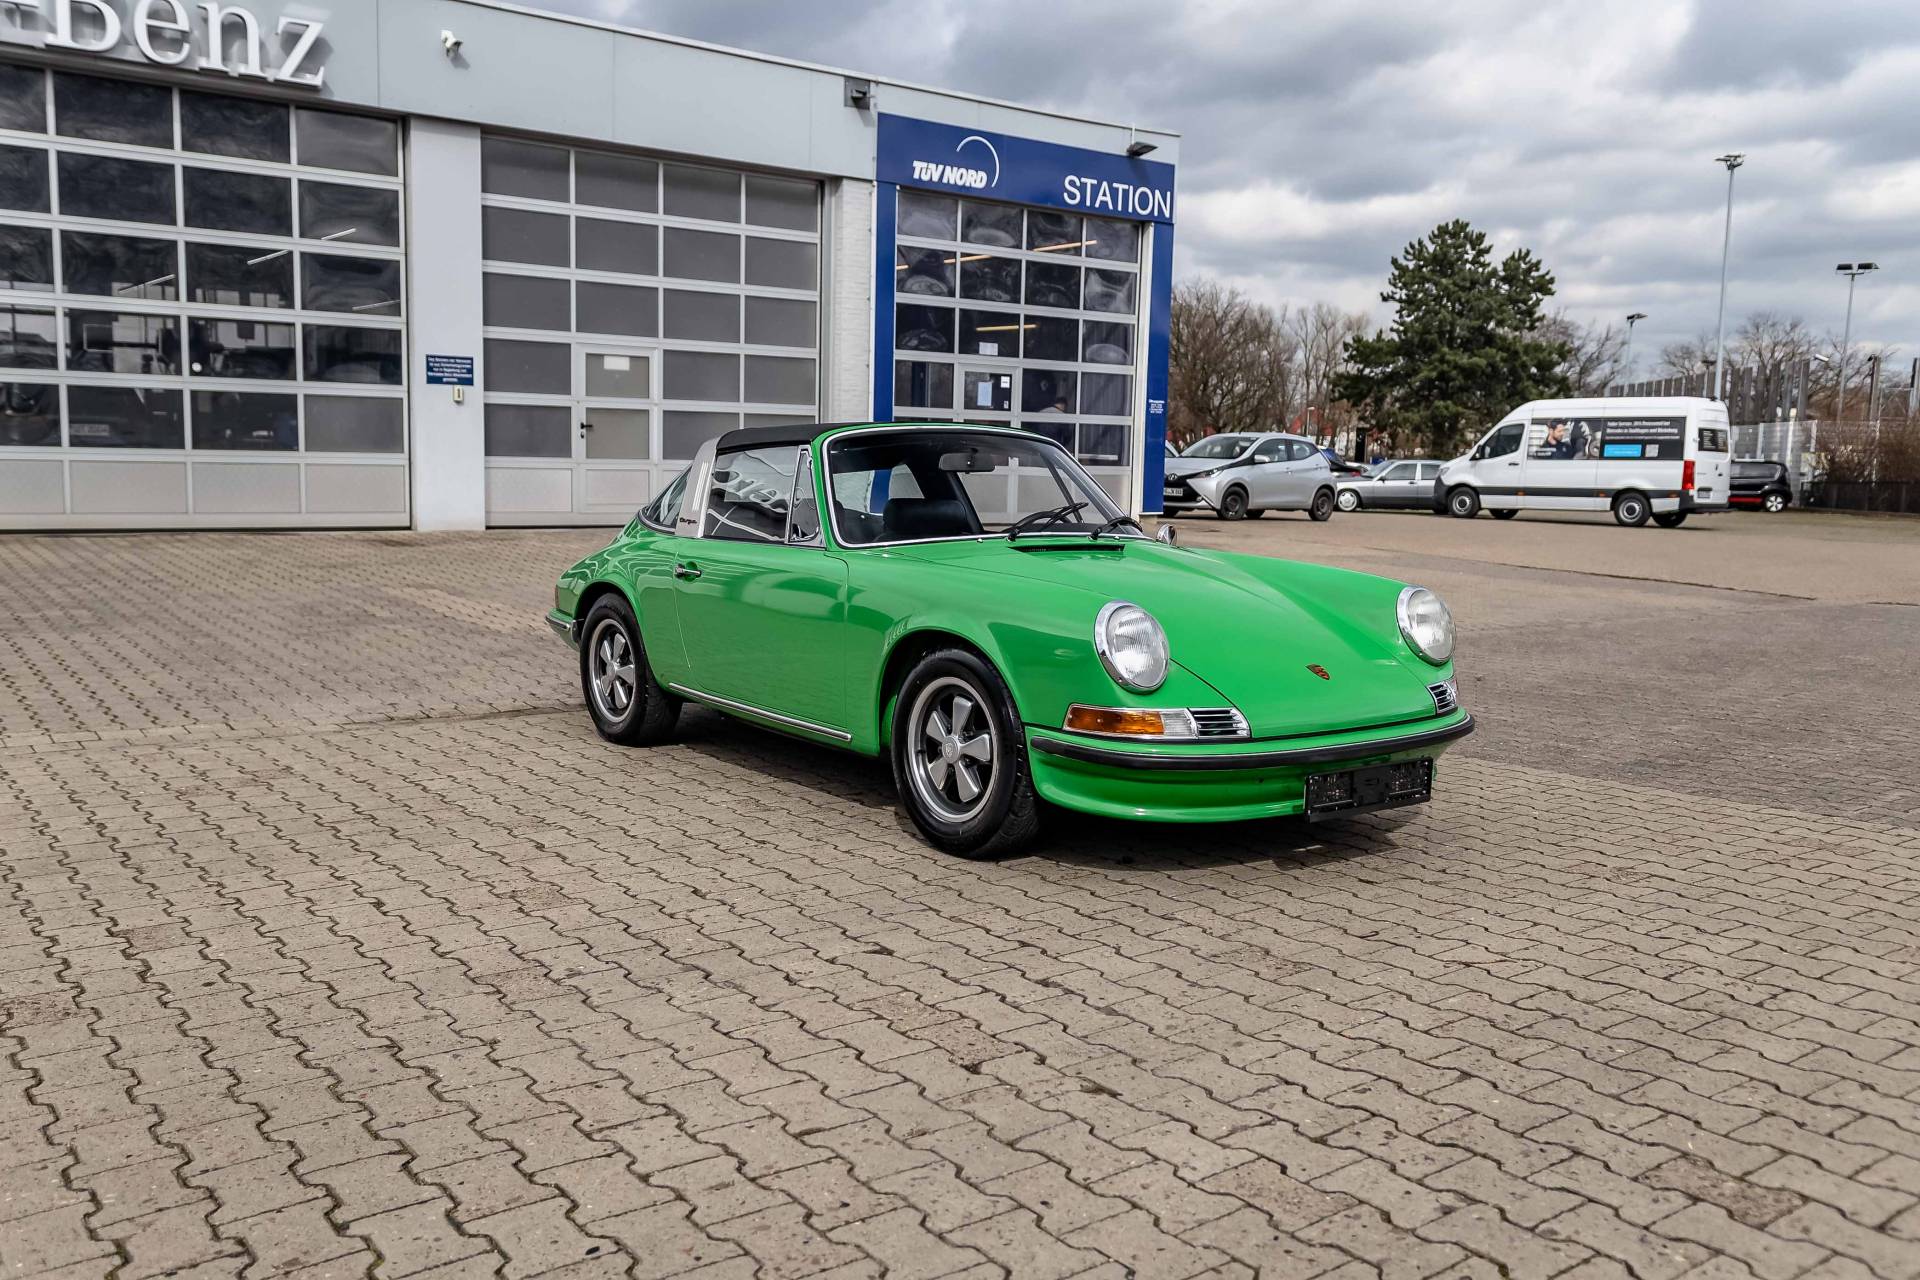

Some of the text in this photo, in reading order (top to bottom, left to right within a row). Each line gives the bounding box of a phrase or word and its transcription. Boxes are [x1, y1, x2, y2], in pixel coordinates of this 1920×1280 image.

[912, 160, 988, 189] TÜV NORD
[1063, 175, 1171, 218] STATION
